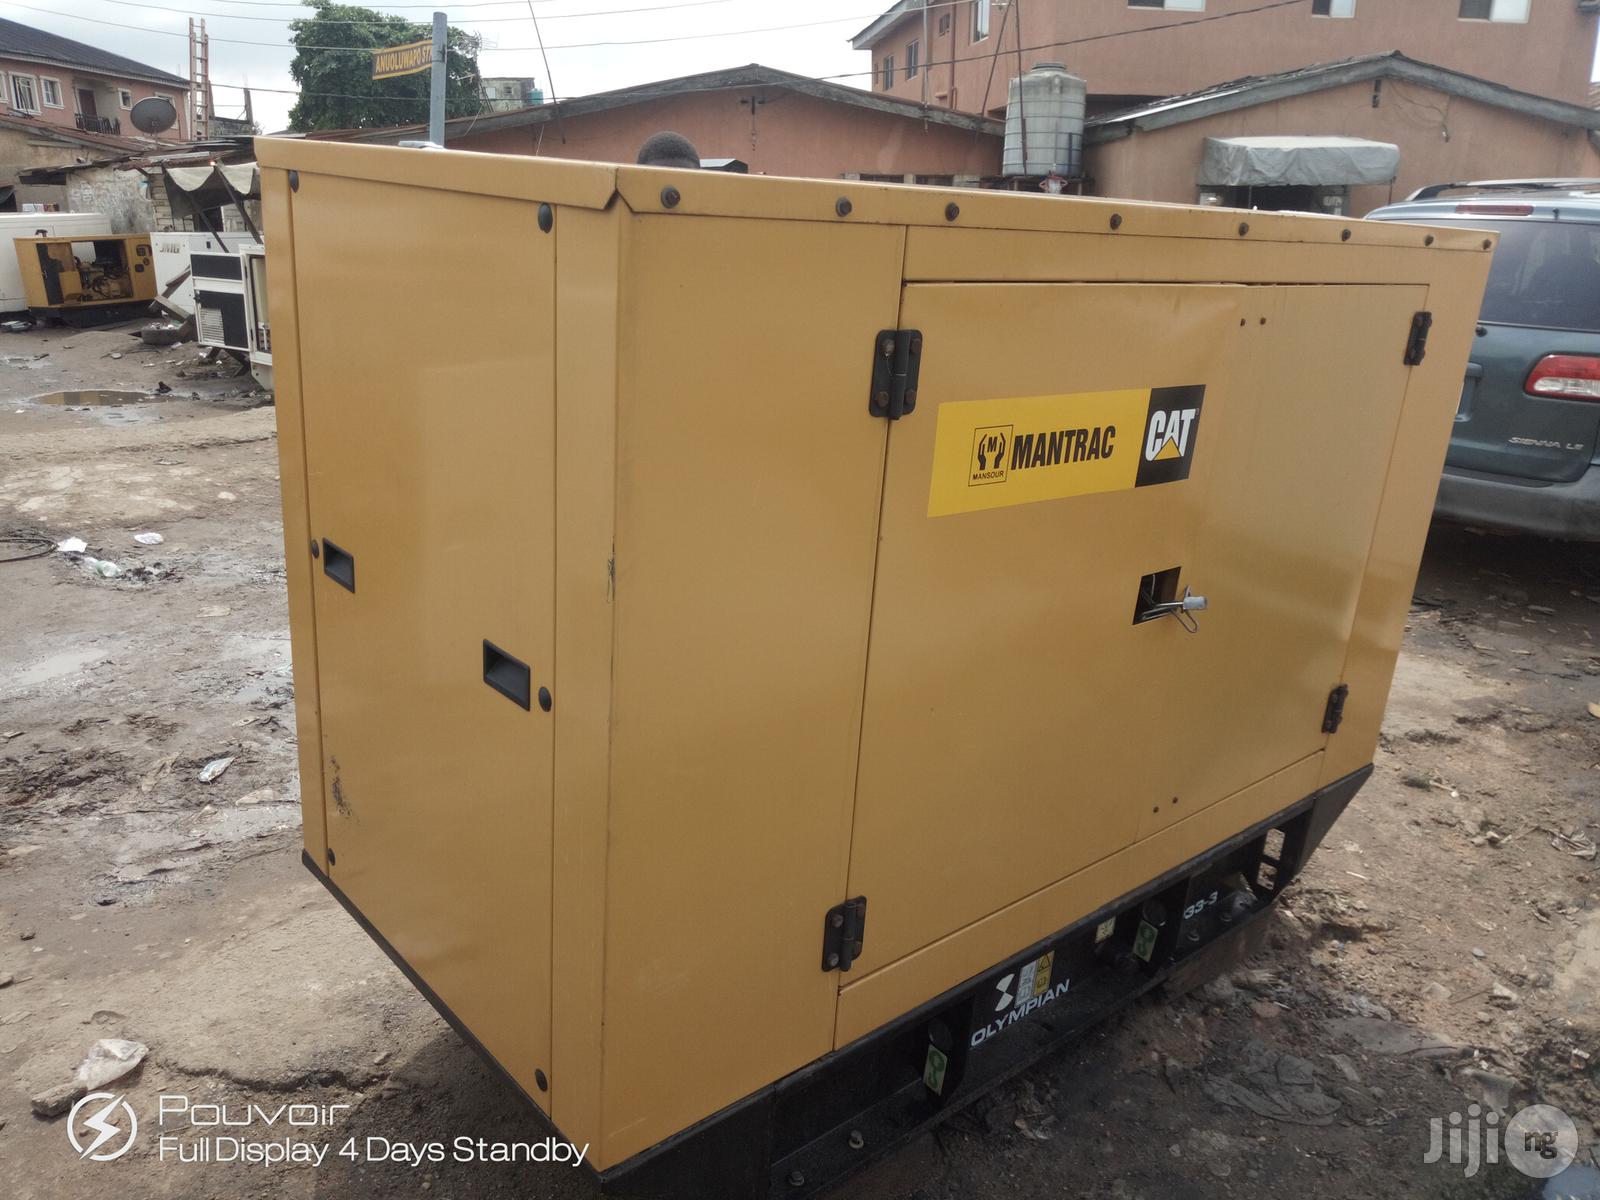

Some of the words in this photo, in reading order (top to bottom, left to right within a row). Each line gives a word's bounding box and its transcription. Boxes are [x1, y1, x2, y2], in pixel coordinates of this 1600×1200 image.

[1010, 425, 1116, 471] MANTRAC
[1145, 408, 1197, 461] CAT
[1508, 436, 1561, 448] SIENNA
[971, 470, 1005, 481] MANSOUR
[970, 978, 1070, 1048] OLYMPIAN
